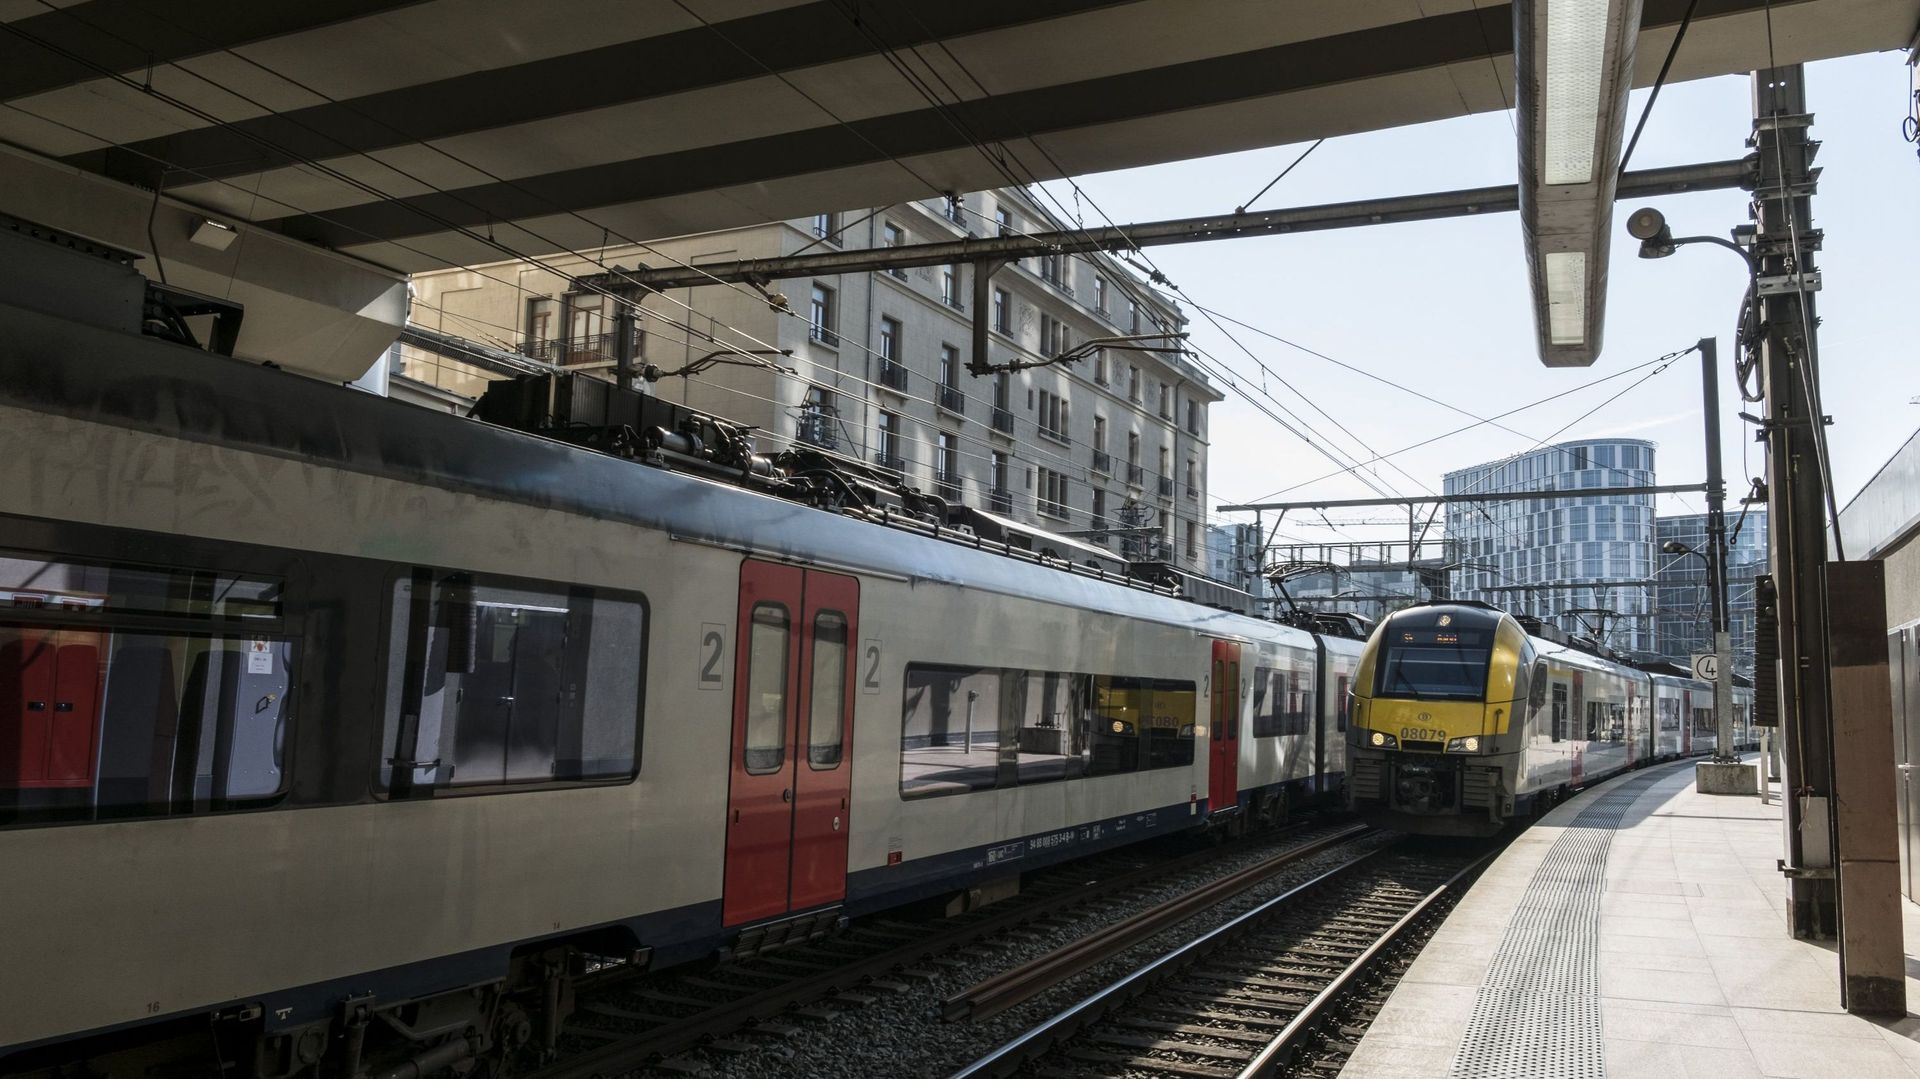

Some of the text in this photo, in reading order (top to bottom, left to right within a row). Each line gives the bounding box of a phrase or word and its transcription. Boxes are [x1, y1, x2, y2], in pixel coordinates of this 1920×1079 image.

[701, 631, 723, 683] 2
[864, 646, 880, 689] 2
[1705, 660, 1716, 676] 4
[1204, 674, 1209, 698] 2
[1242, 678, 1247, 699] 2
[1401, 727, 1446, 741] 08079
[147, 1001, 160, 1013] 16
